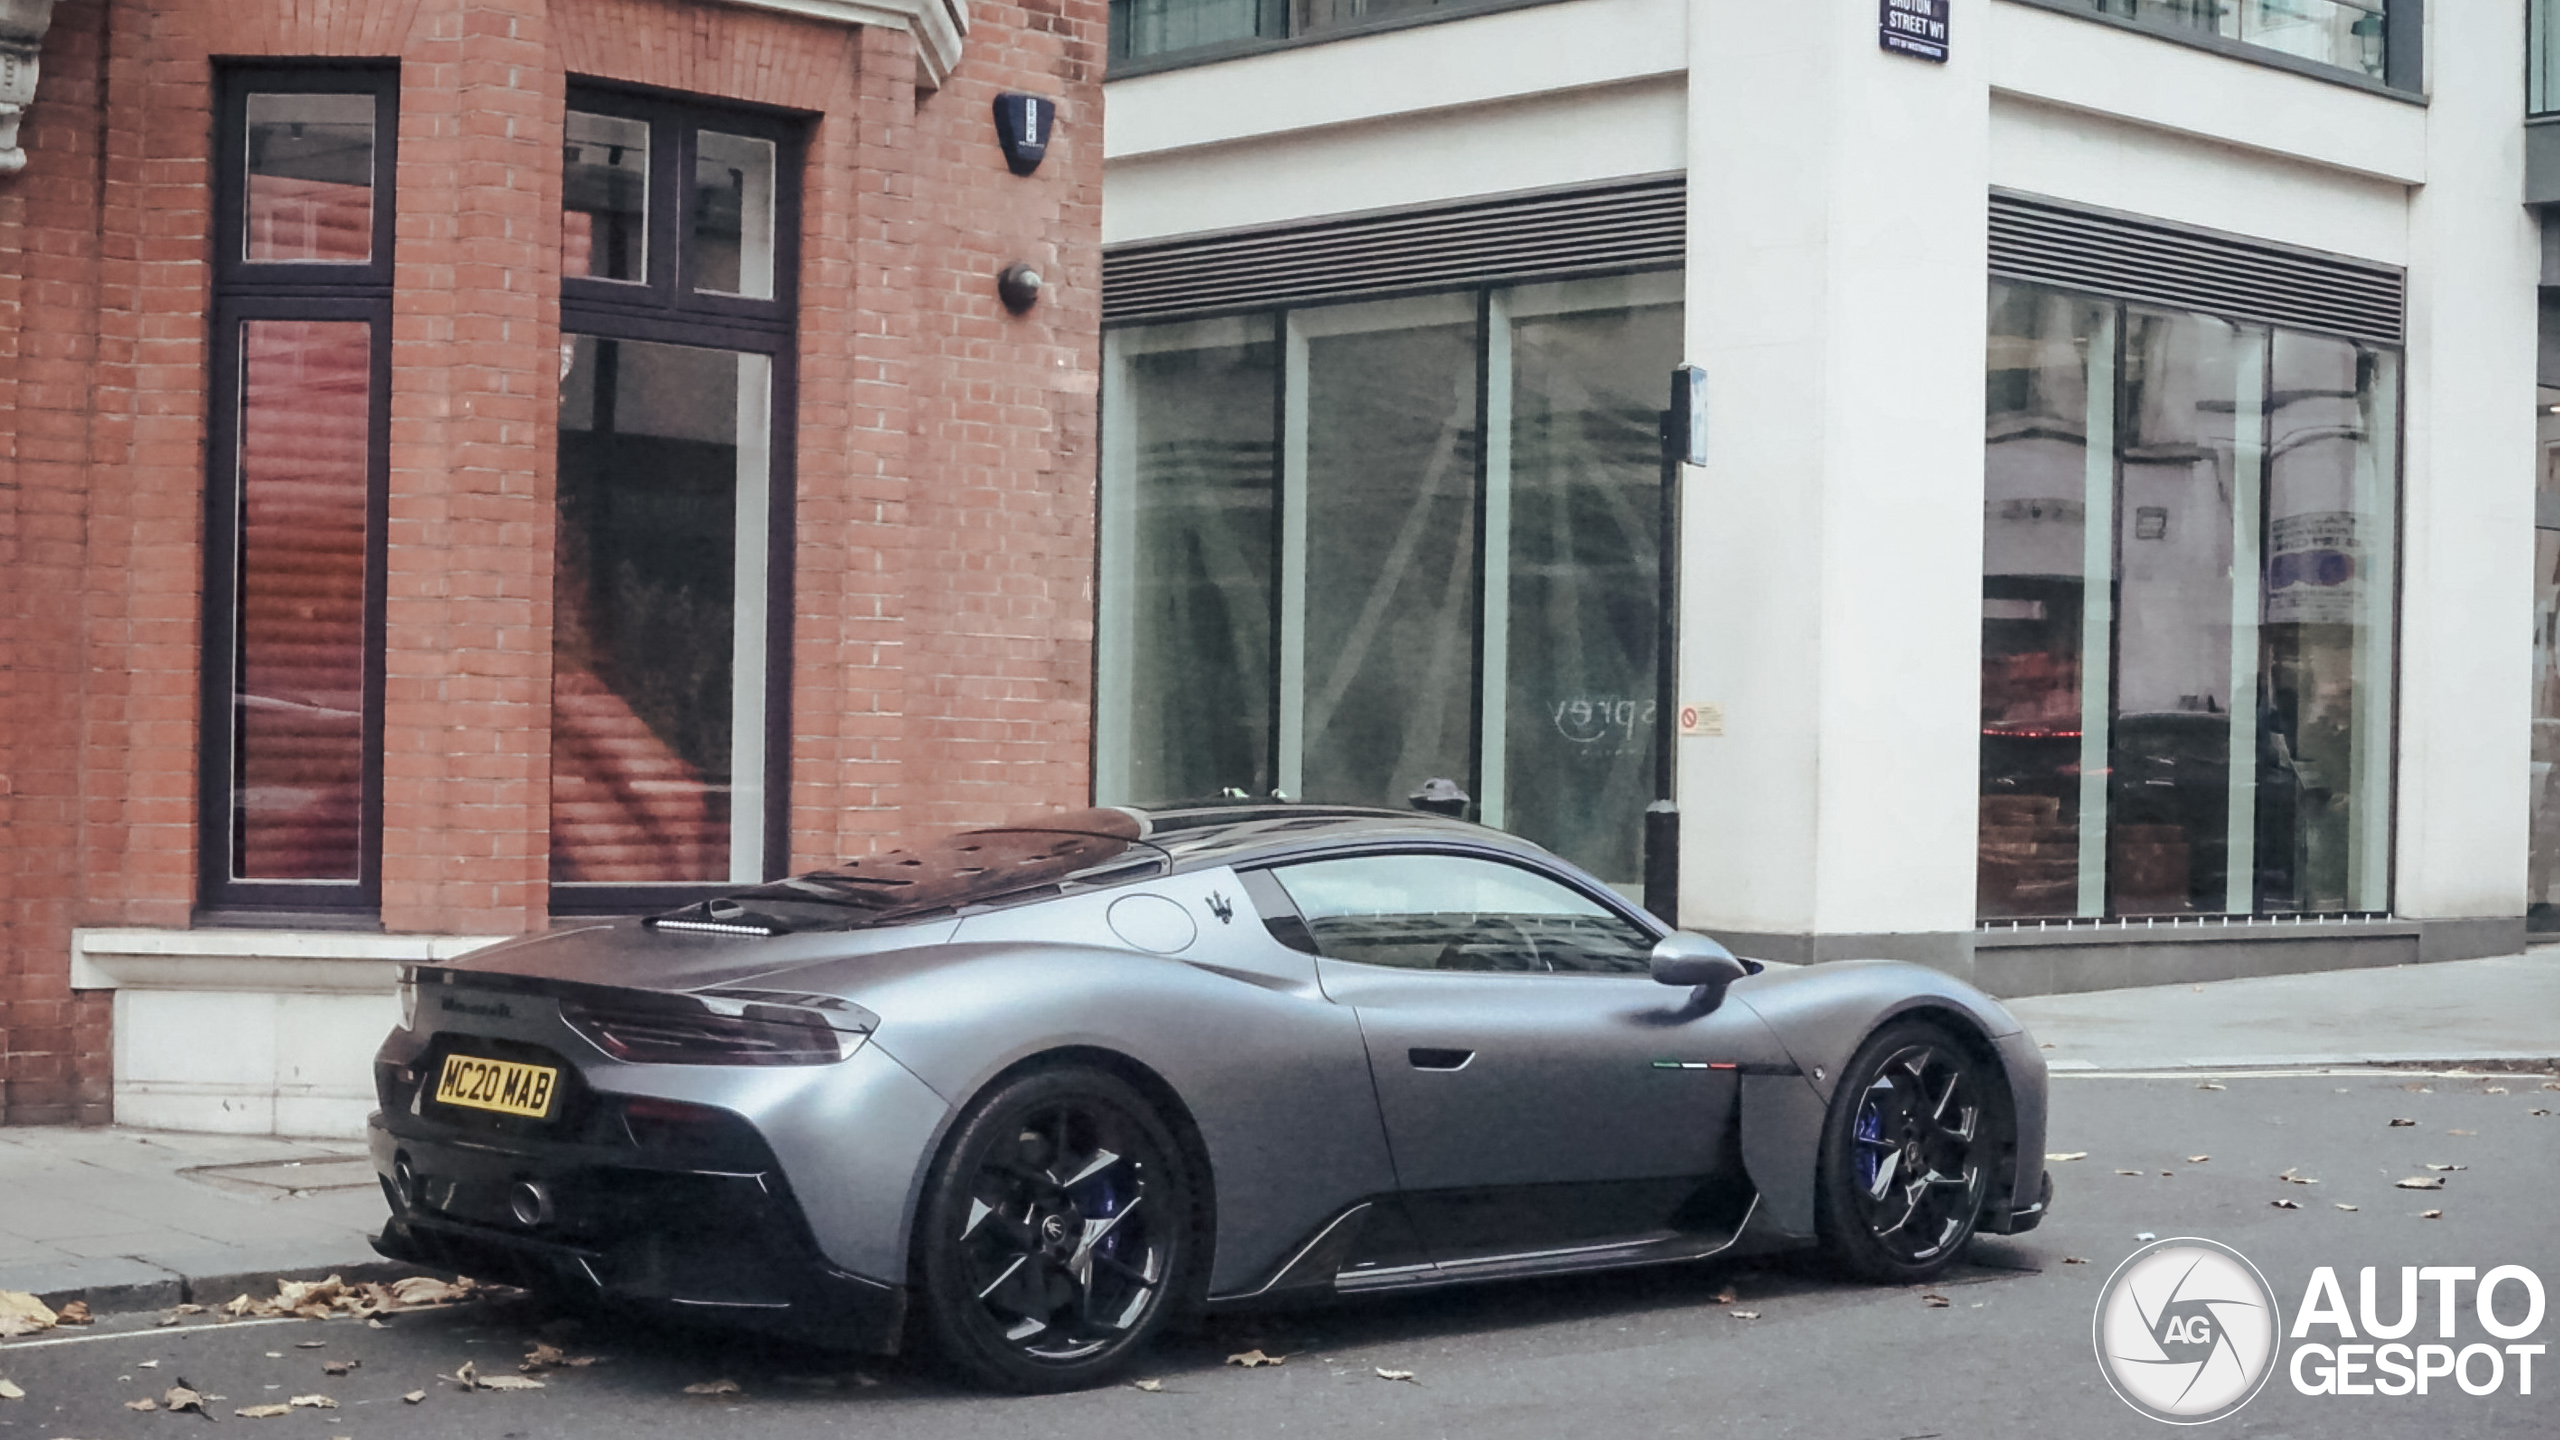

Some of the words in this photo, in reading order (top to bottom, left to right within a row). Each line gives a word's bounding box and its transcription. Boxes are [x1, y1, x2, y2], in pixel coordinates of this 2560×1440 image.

[1889, 10, 1928, 35] STREET
[1929, 19, 1945, 39] W1
[441, 1060, 501, 1102] MC20
[501, 1067, 551, 1110] MAB
